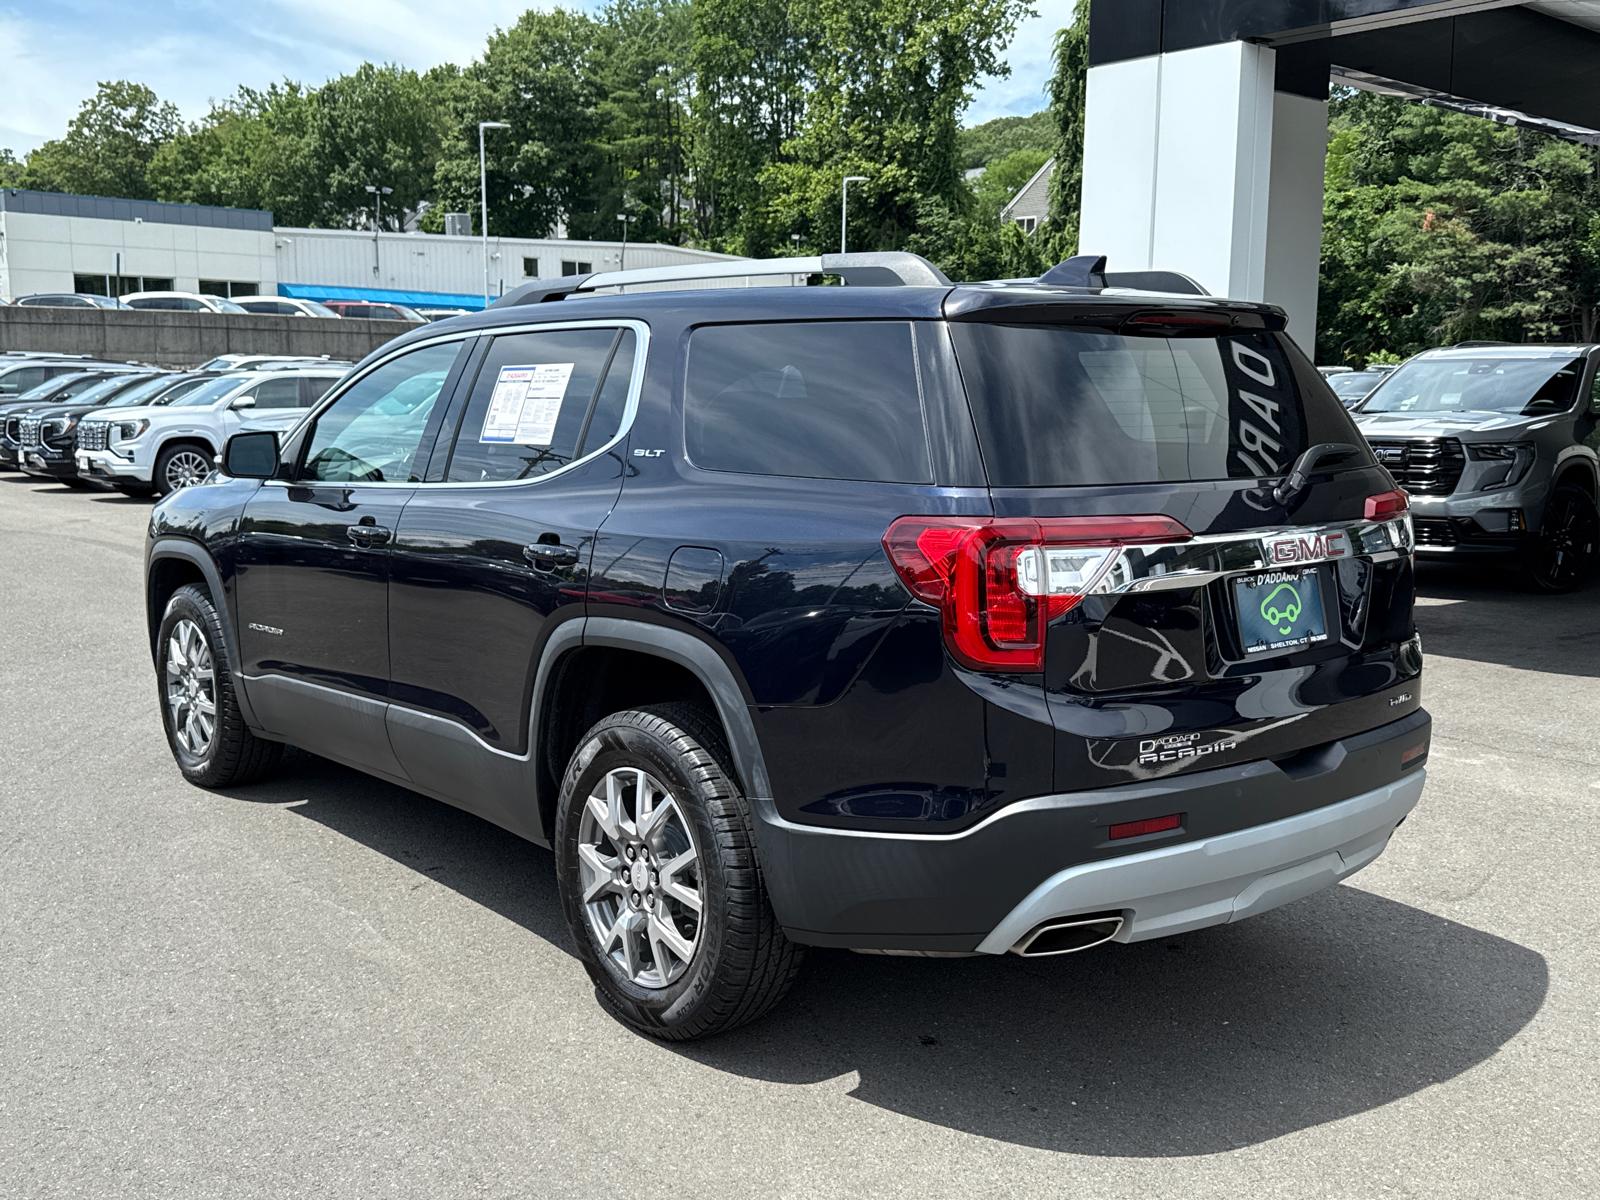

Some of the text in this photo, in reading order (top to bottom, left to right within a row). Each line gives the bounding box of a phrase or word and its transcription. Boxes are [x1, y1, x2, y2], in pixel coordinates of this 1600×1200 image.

[633, 449, 665, 458] SLT
[1273, 534, 1345, 562] GMC
[1236, 576, 1255, 584] BUICK
[1302, 567, 1318, 575] GMC
[1247, 645, 1267, 653] NISSAN
[1139, 742, 1237, 764] ACADIA
[676, 999, 696, 1019] PLUS
